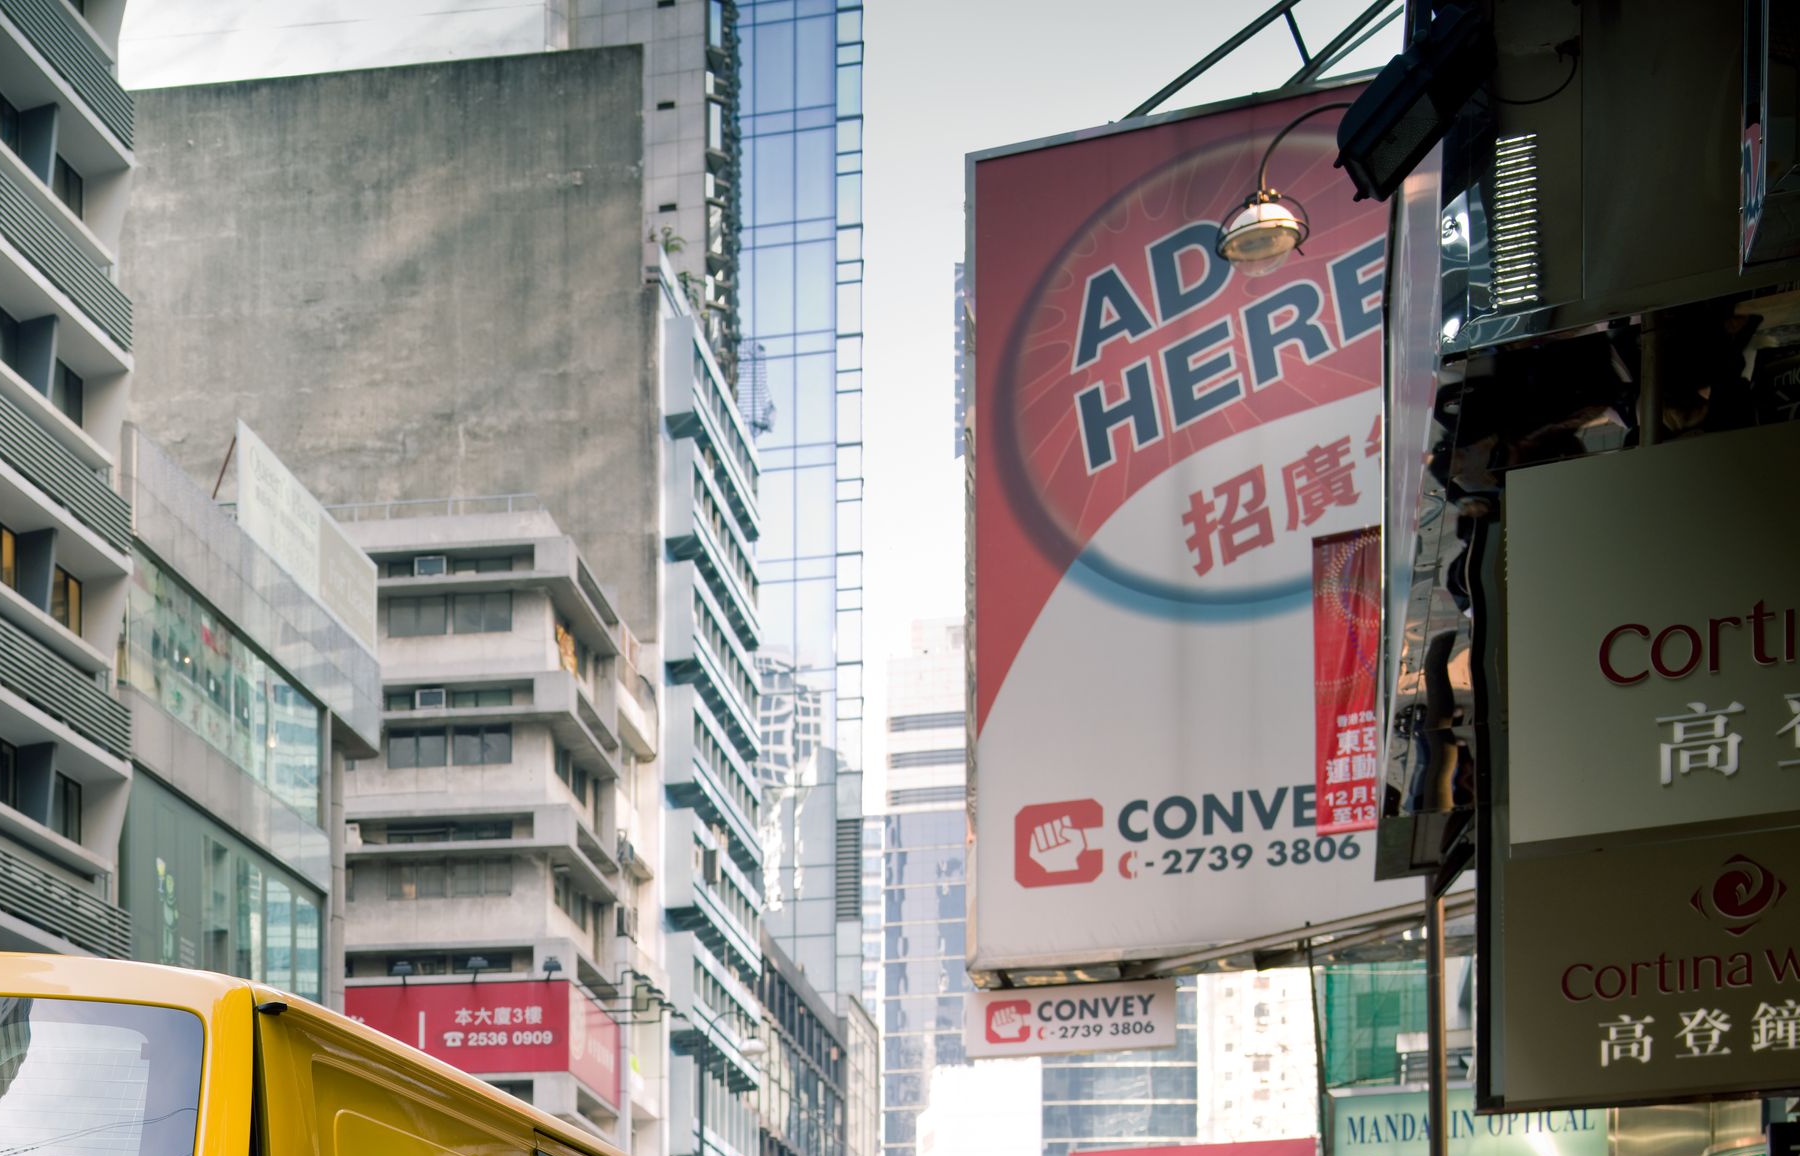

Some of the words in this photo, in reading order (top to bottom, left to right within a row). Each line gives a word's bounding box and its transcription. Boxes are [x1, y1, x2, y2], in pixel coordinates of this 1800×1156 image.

[1118, 786, 1316, 842] CONVE
[1266, 834, 1361, 867] 3806
[1561, 952, 1753, 1001] cortina
[454, 1006, 543, 1026] 本大廈3樓
[1037, 994, 1155, 1022] CONVEY
[467, 1032, 508, 1046] 2536
[512, 1030, 553, 1045] 0909
[1109, 1020, 1155, 1035] 3806
[1347, 1109, 1475, 1145] MANDAIN
[1487, 1108, 1595, 1137] OPTICAL
